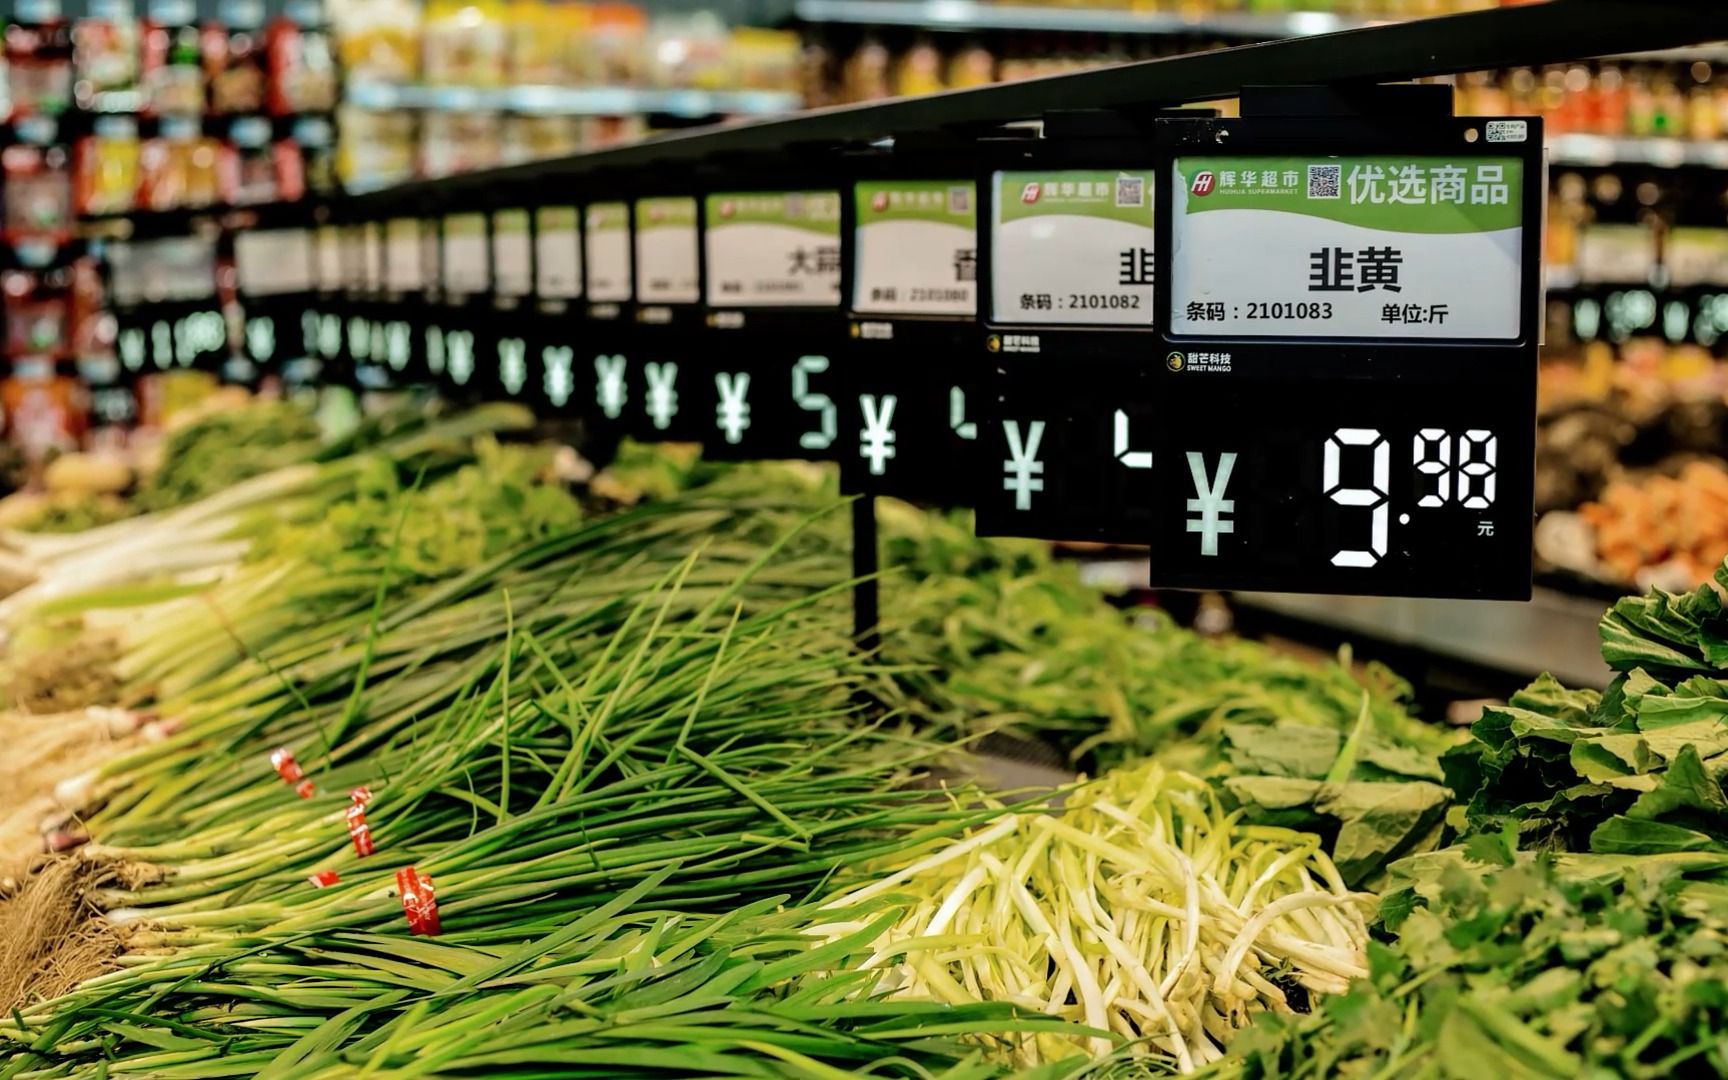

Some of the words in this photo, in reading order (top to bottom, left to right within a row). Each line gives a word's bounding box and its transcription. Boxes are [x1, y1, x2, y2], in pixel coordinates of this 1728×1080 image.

[1219, 171, 1299, 187] 辉华超市
[1346, 165, 1509, 205] 优选商品
[1308, 246, 1403, 293] 韭黄
[1187, 352, 1231, 364] 甜芒科技
[1187, 364, 1207, 372] SWEET
[1208, 364, 1232, 372] MANGO
[1477, 520, 1495, 537] 元
